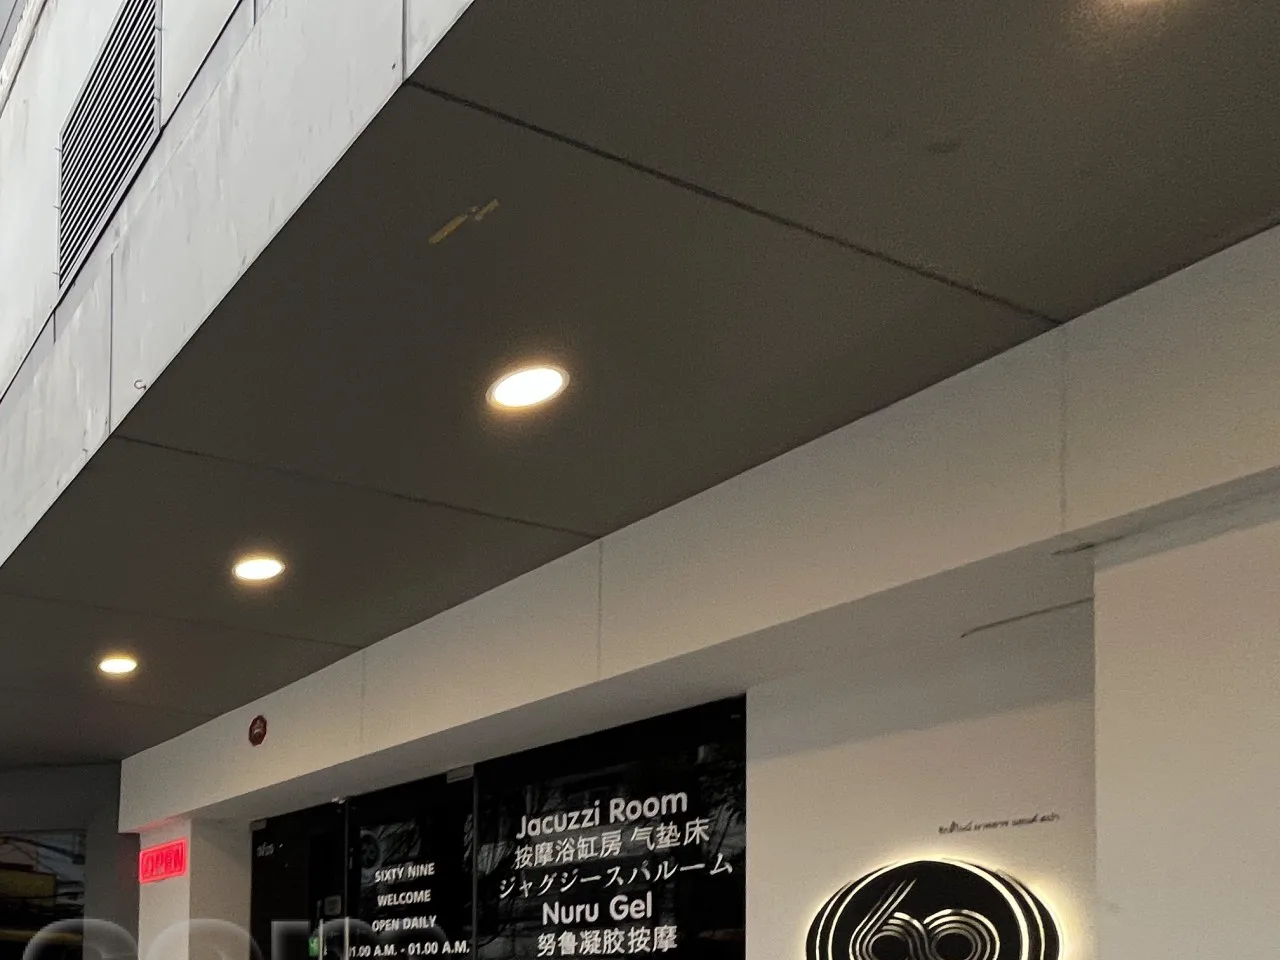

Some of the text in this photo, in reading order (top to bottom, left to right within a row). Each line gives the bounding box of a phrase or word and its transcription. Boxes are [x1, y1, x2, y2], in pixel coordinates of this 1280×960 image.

[515, 791, 689, 840] Jacuzzi Room
[513, 816, 711, 870] 按摩浴缸房 气垫床
[374, 862, 436, 883] SIXTY NINE
[377, 889, 432, 907] WELCOME
[542, 891, 653, 926] Nuru Gel
[371, 915, 438, 932] OPEN DAILY
[373, 943, 398, 957] A.M.
[407, 941, 439, 955] 01.00
[441, 940, 471, 954] A.M.
